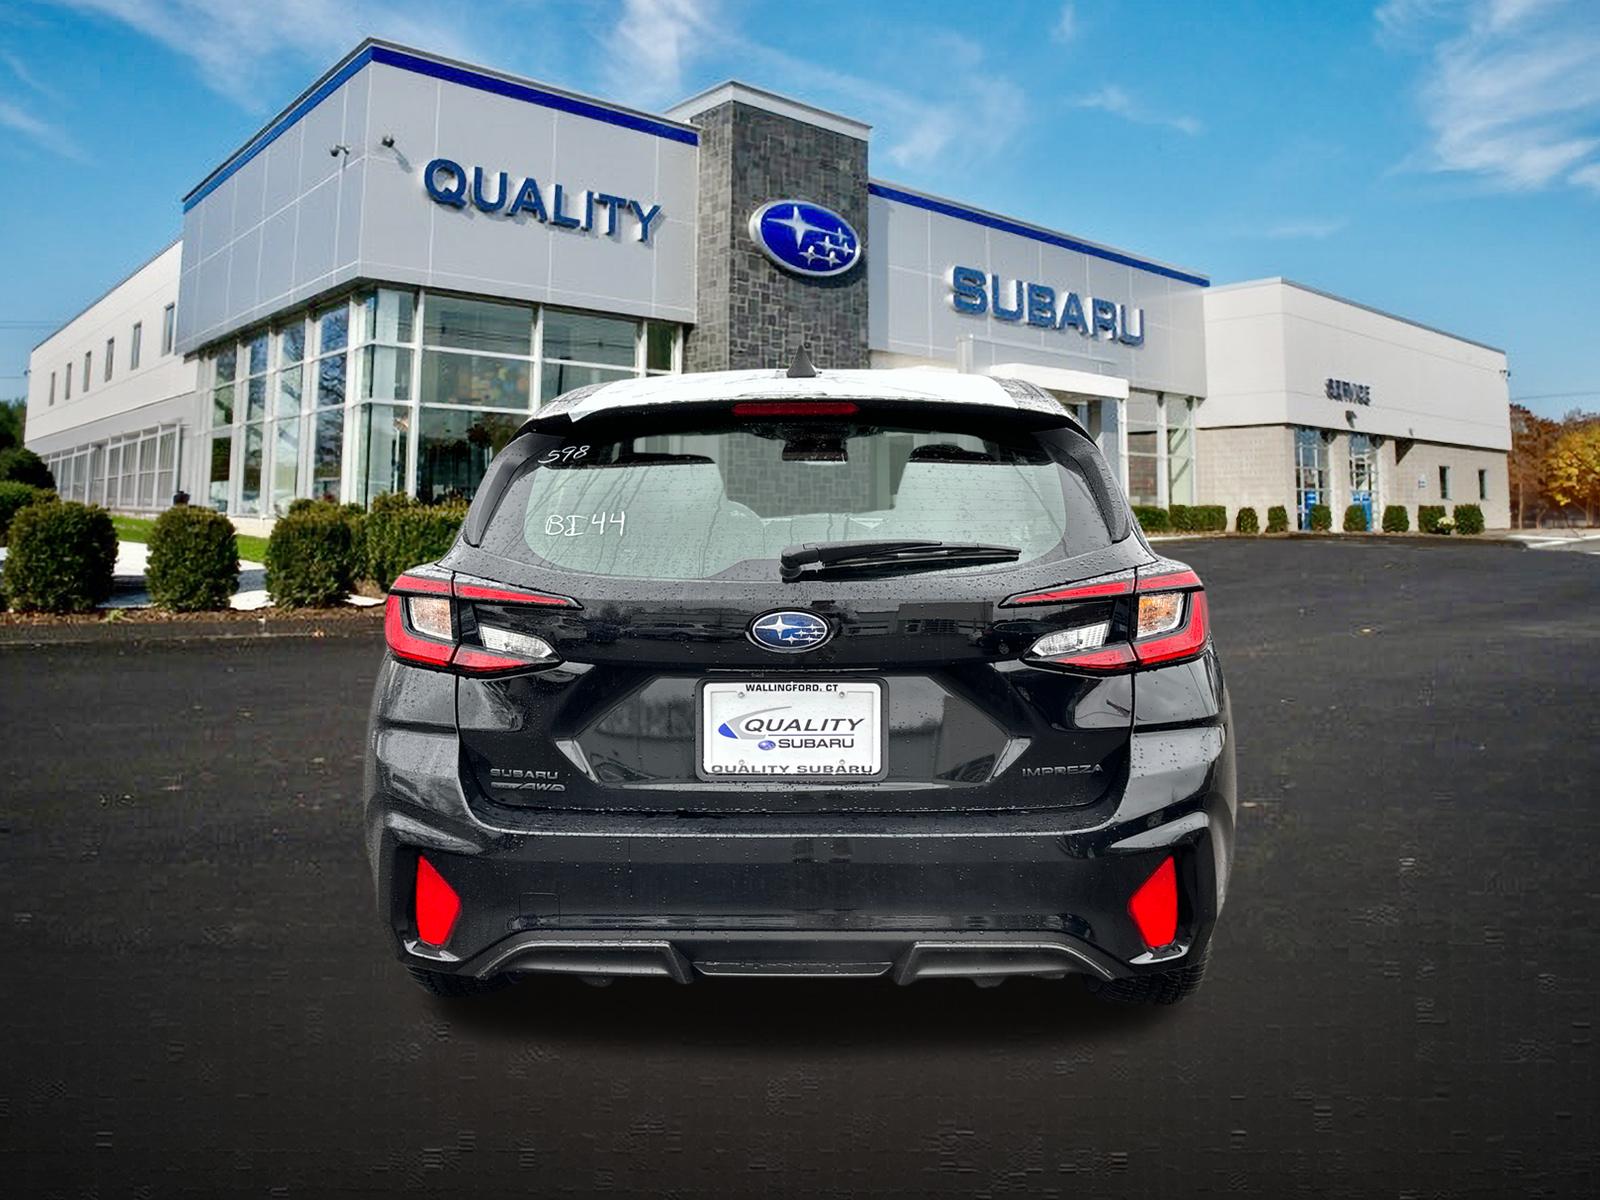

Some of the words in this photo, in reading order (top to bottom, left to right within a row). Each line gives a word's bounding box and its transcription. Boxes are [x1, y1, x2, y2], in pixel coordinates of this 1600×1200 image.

[424, 158, 661, 243] QUALITY
[947, 265, 1145, 346] SUBARU
[1325, 378, 1371, 407] SERVICE
[538, 445, 591, 464] 598
[825, 683, 839, 692] CT
[744, 718, 865, 732] QUALITY
[778, 738, 855, 749] SUBARU
[490, 768, 559, 779] SUBARU
[711, 765, 790, 774] QUALITY
[796, 764, 874, 774] SUBARU
[1022, 763, 1104, 777] IMPREZA
[519, 782, 566, 792] AWD
